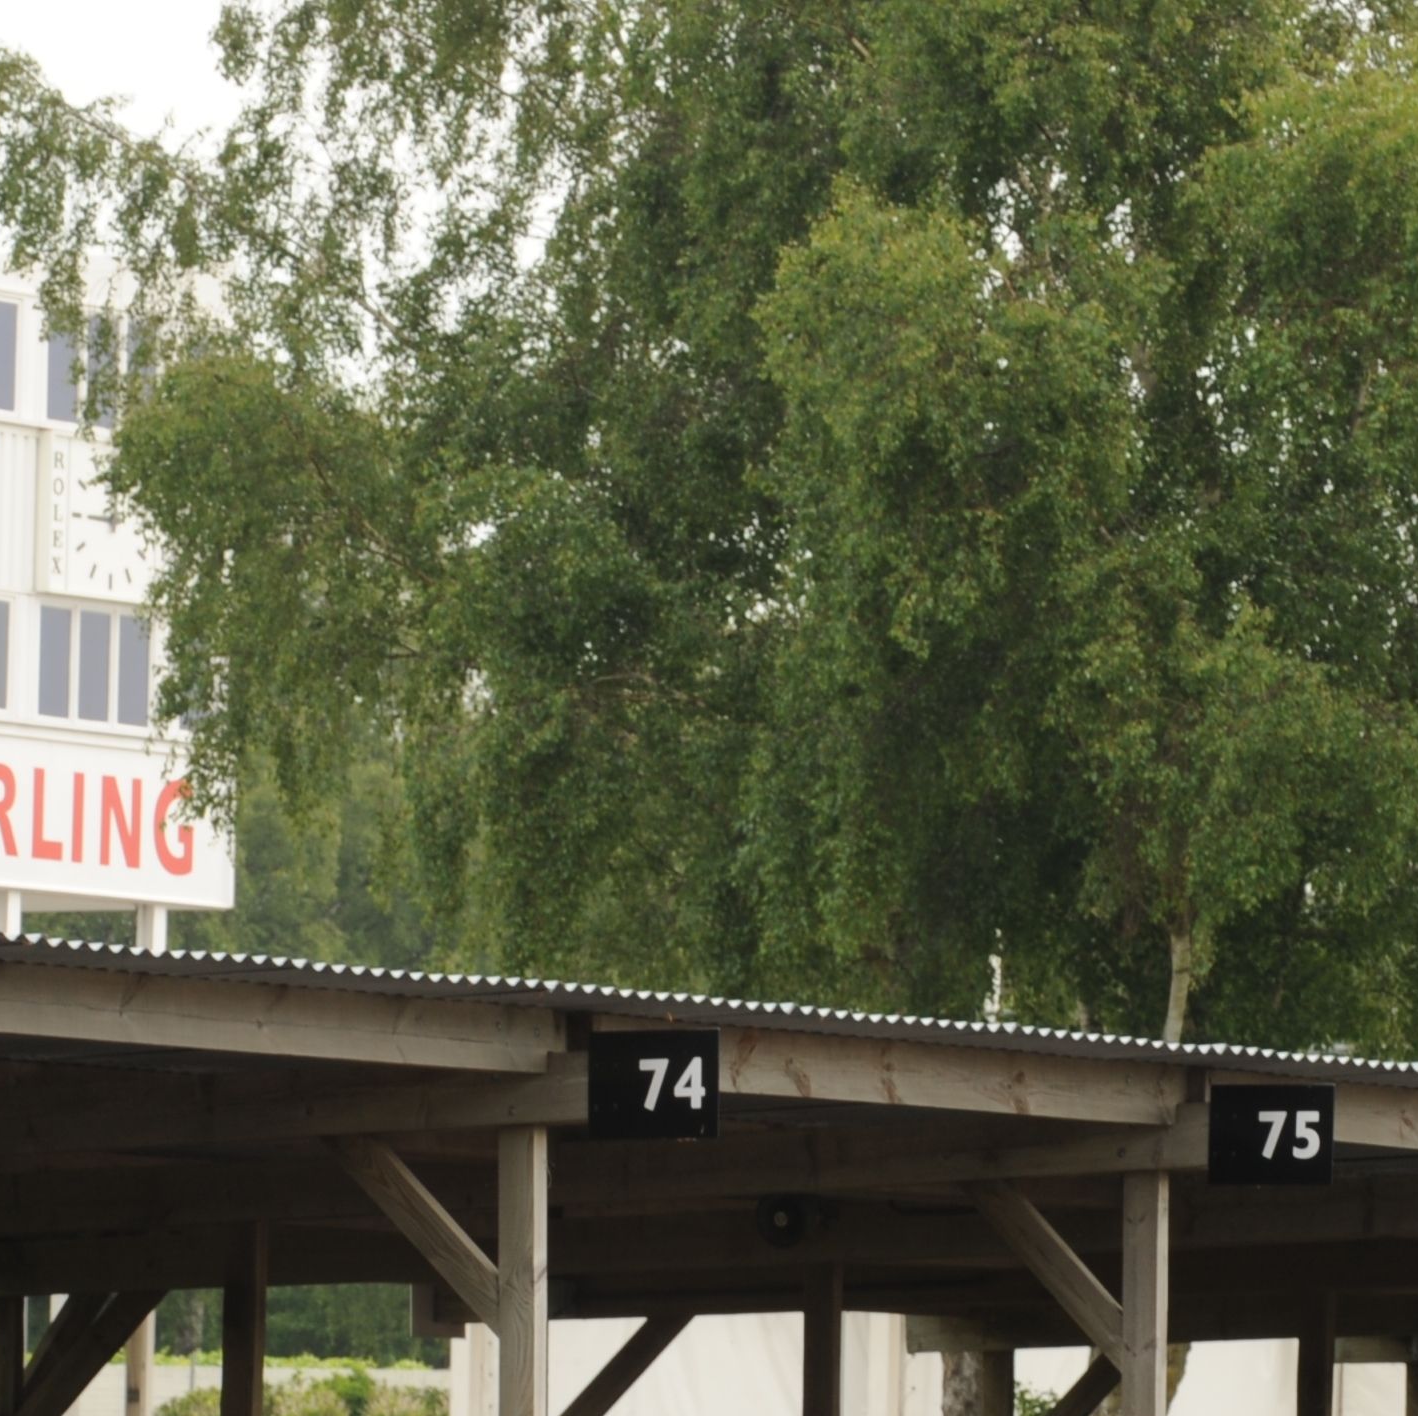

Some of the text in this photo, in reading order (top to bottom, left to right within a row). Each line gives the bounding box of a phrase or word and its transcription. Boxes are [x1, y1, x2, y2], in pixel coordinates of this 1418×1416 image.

[52, 451, 64, 575] ROLEX
[638, 1056, 706, 1111] 74
[1258, 1110, 1321, 1160] 75
